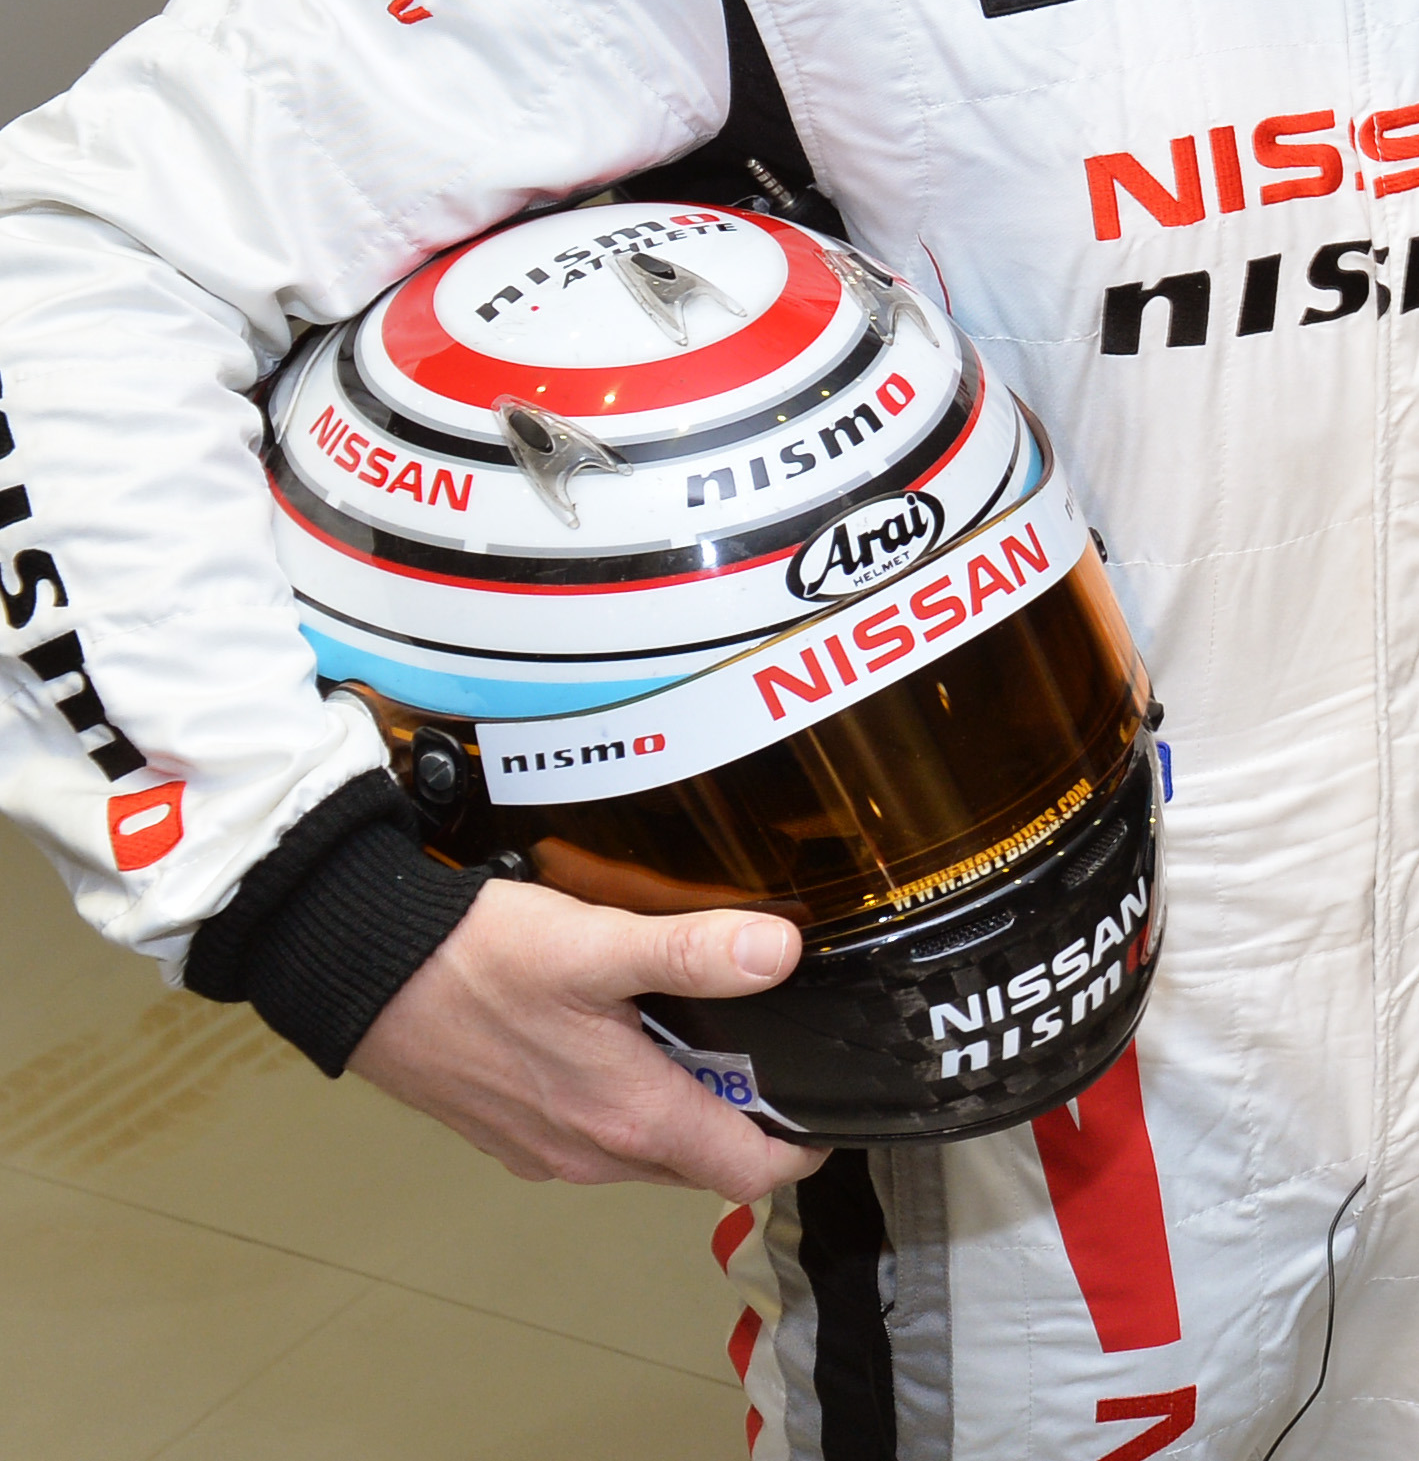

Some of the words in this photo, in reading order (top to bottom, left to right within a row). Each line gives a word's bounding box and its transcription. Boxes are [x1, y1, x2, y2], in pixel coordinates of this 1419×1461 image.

[562, 221, 738, 290] ATHLETE
[308, 405, 474, 512] NISSAN
[802, 492, 931, 598] Arai
[853, 549, 911, 588] HELMET
[752, 522, 1051, 721] NISSAN
[929, 876, 1149, 1041] NISSAN
[680, 1064, 753, 1106] 08
